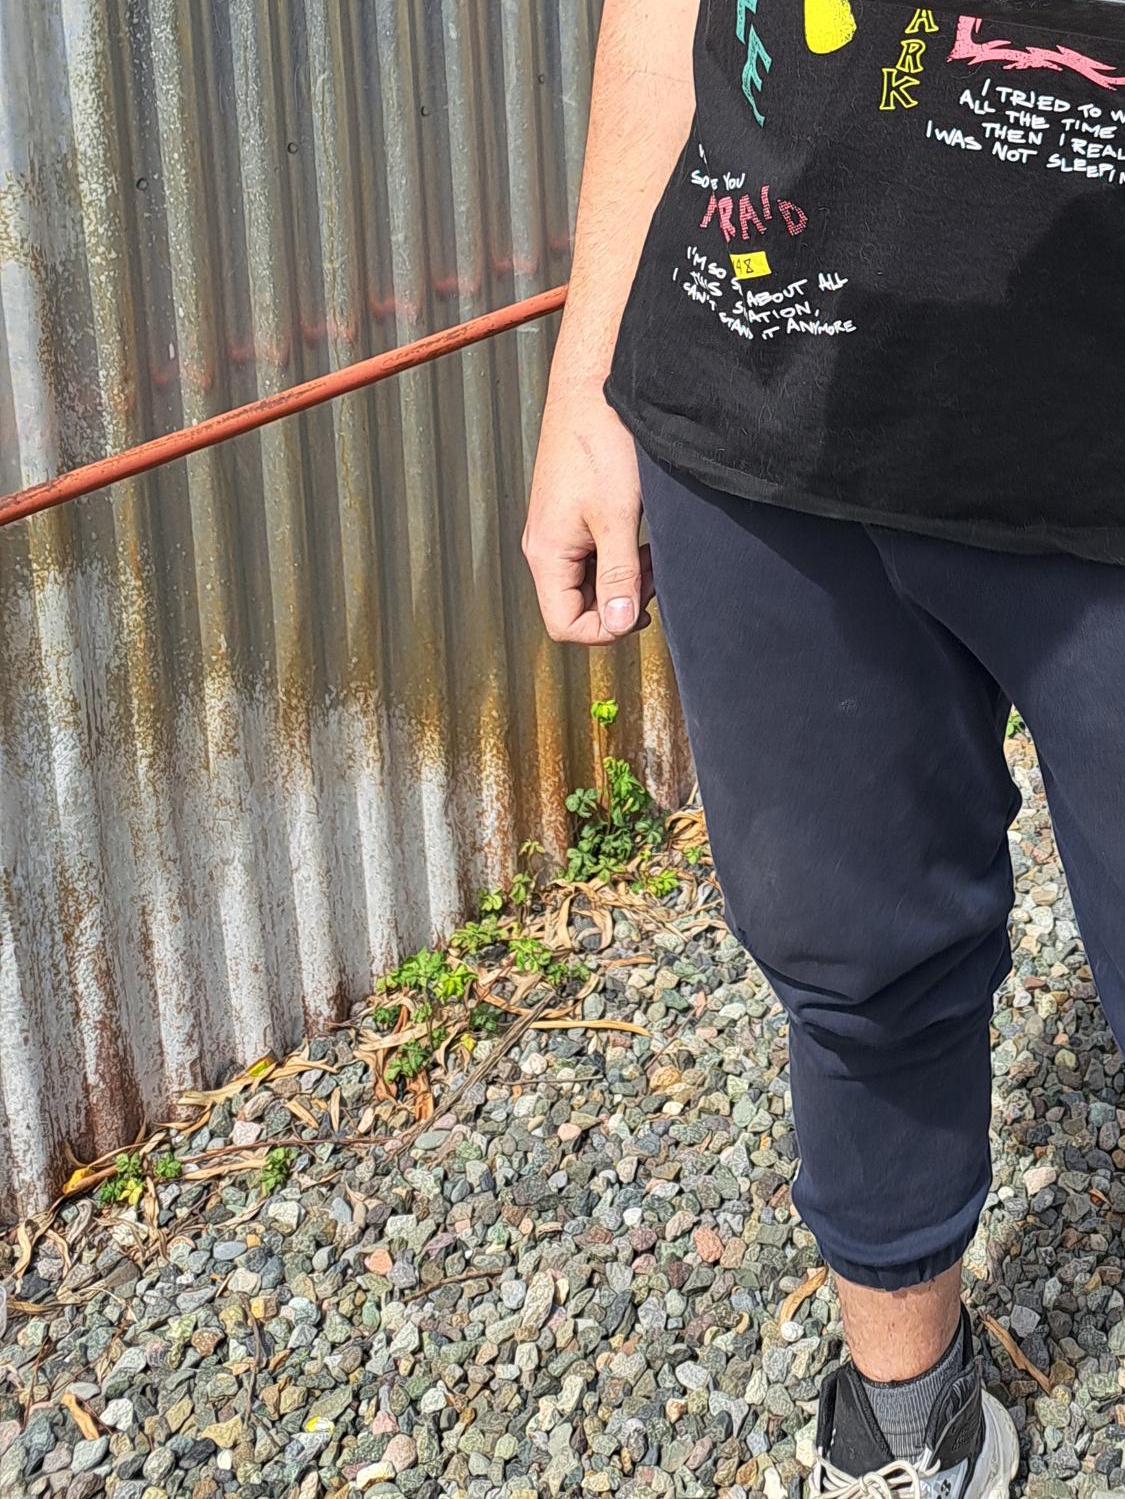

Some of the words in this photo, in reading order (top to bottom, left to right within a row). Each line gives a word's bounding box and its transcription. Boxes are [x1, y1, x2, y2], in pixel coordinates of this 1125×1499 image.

[959, 89, 996, 115] ALL
[1005, 110, 1050, 130] THE
[1060, 118, 1118, 140] TIME
[981, 78, 991, 97] I
[996, 86, 1071, 113] TRIED
[1078, 103, 1102, 118] TO
[925, 119, 933, 139] I
[934, 126, 983, 151] WAS
[992, 142, 1038, 164] NOT
[981, 121, 1043, 145] THEN
[1059, 133, 1066, 146] I
[723, 171, 746, 191] YOU
[672, 267, 679, 281] I
[761, 326, 780, 340] IT
[786, 318, 857, 336] ANYMORE
[708, 262, 727, 279] SO
[746, 279, 808, 307] ABOUT
[818, 272, 849, 292] ALL
